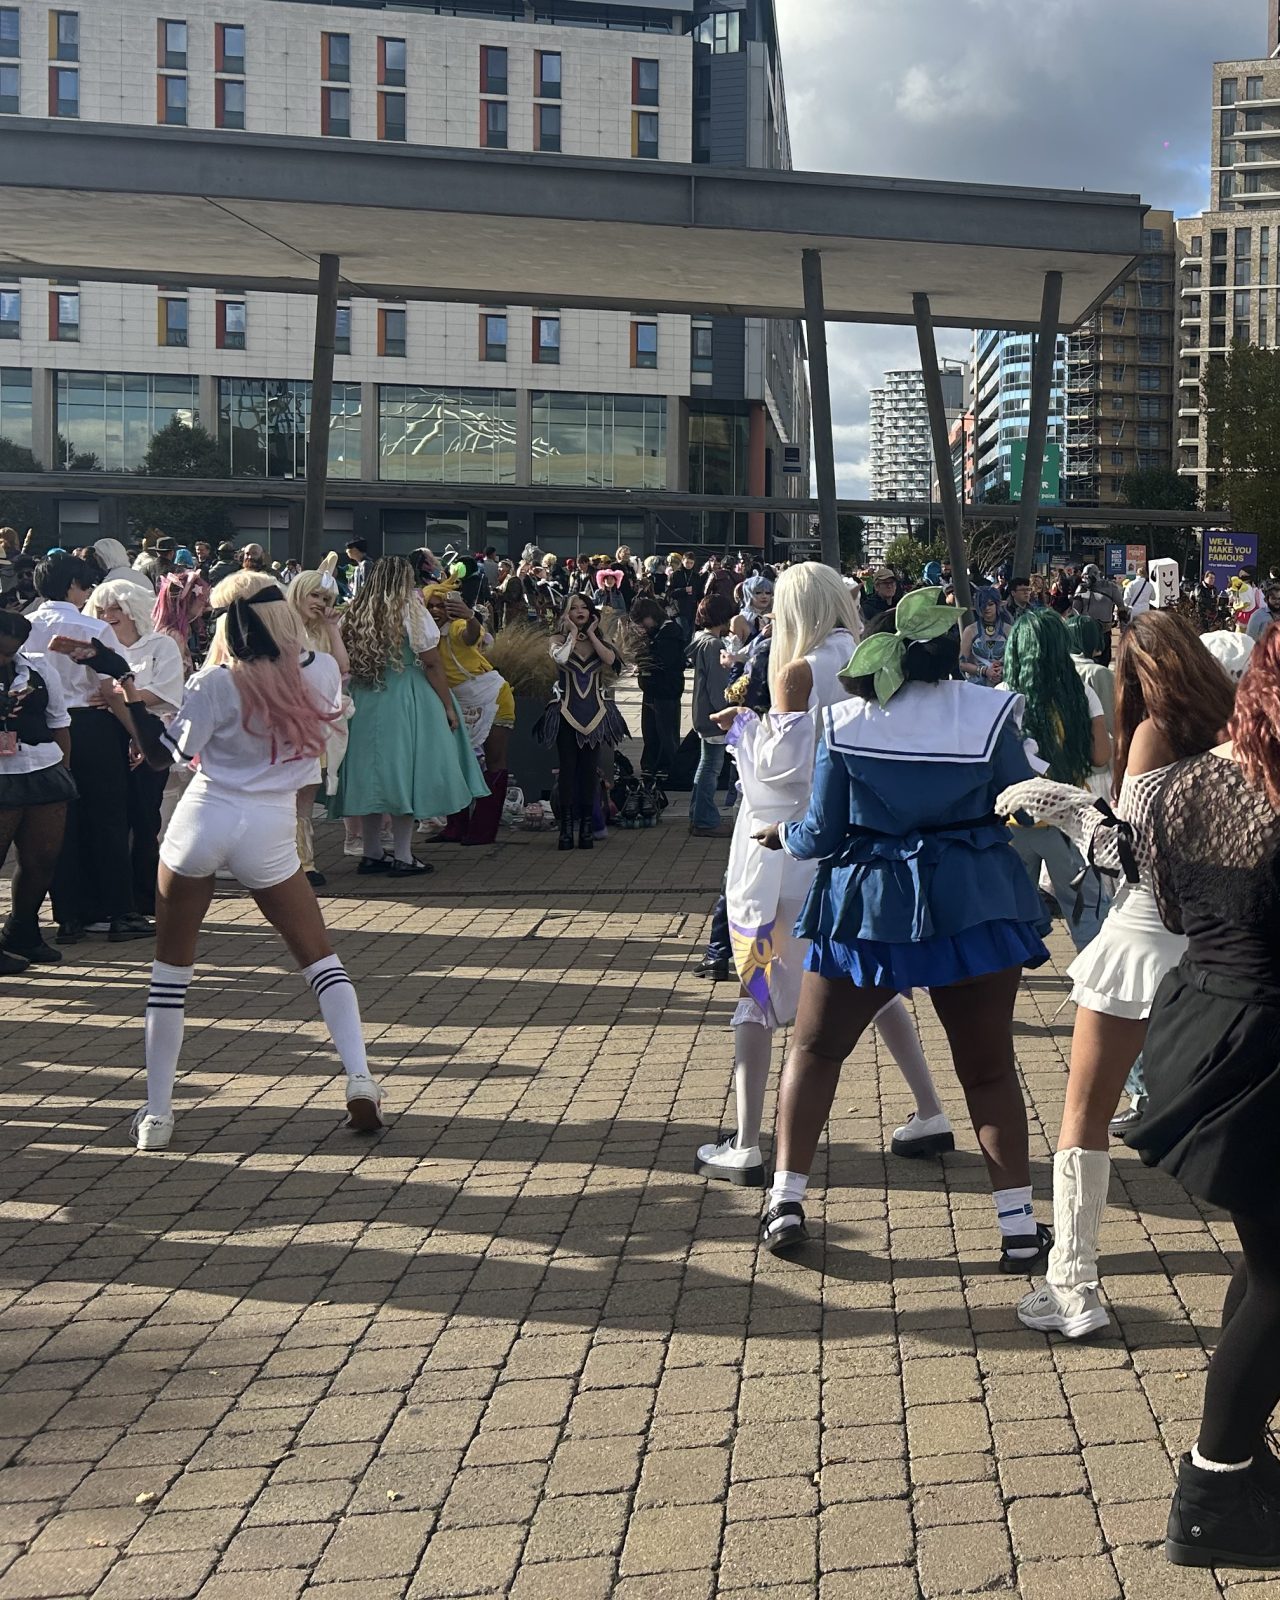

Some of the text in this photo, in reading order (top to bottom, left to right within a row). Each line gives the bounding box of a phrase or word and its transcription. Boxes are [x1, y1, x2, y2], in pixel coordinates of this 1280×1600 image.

[1208, 537, 1234, 546] WE'LL
[1208, 546, 1233, 554] MAKE
[1208, 554, 1244, 562] FAMOUS
